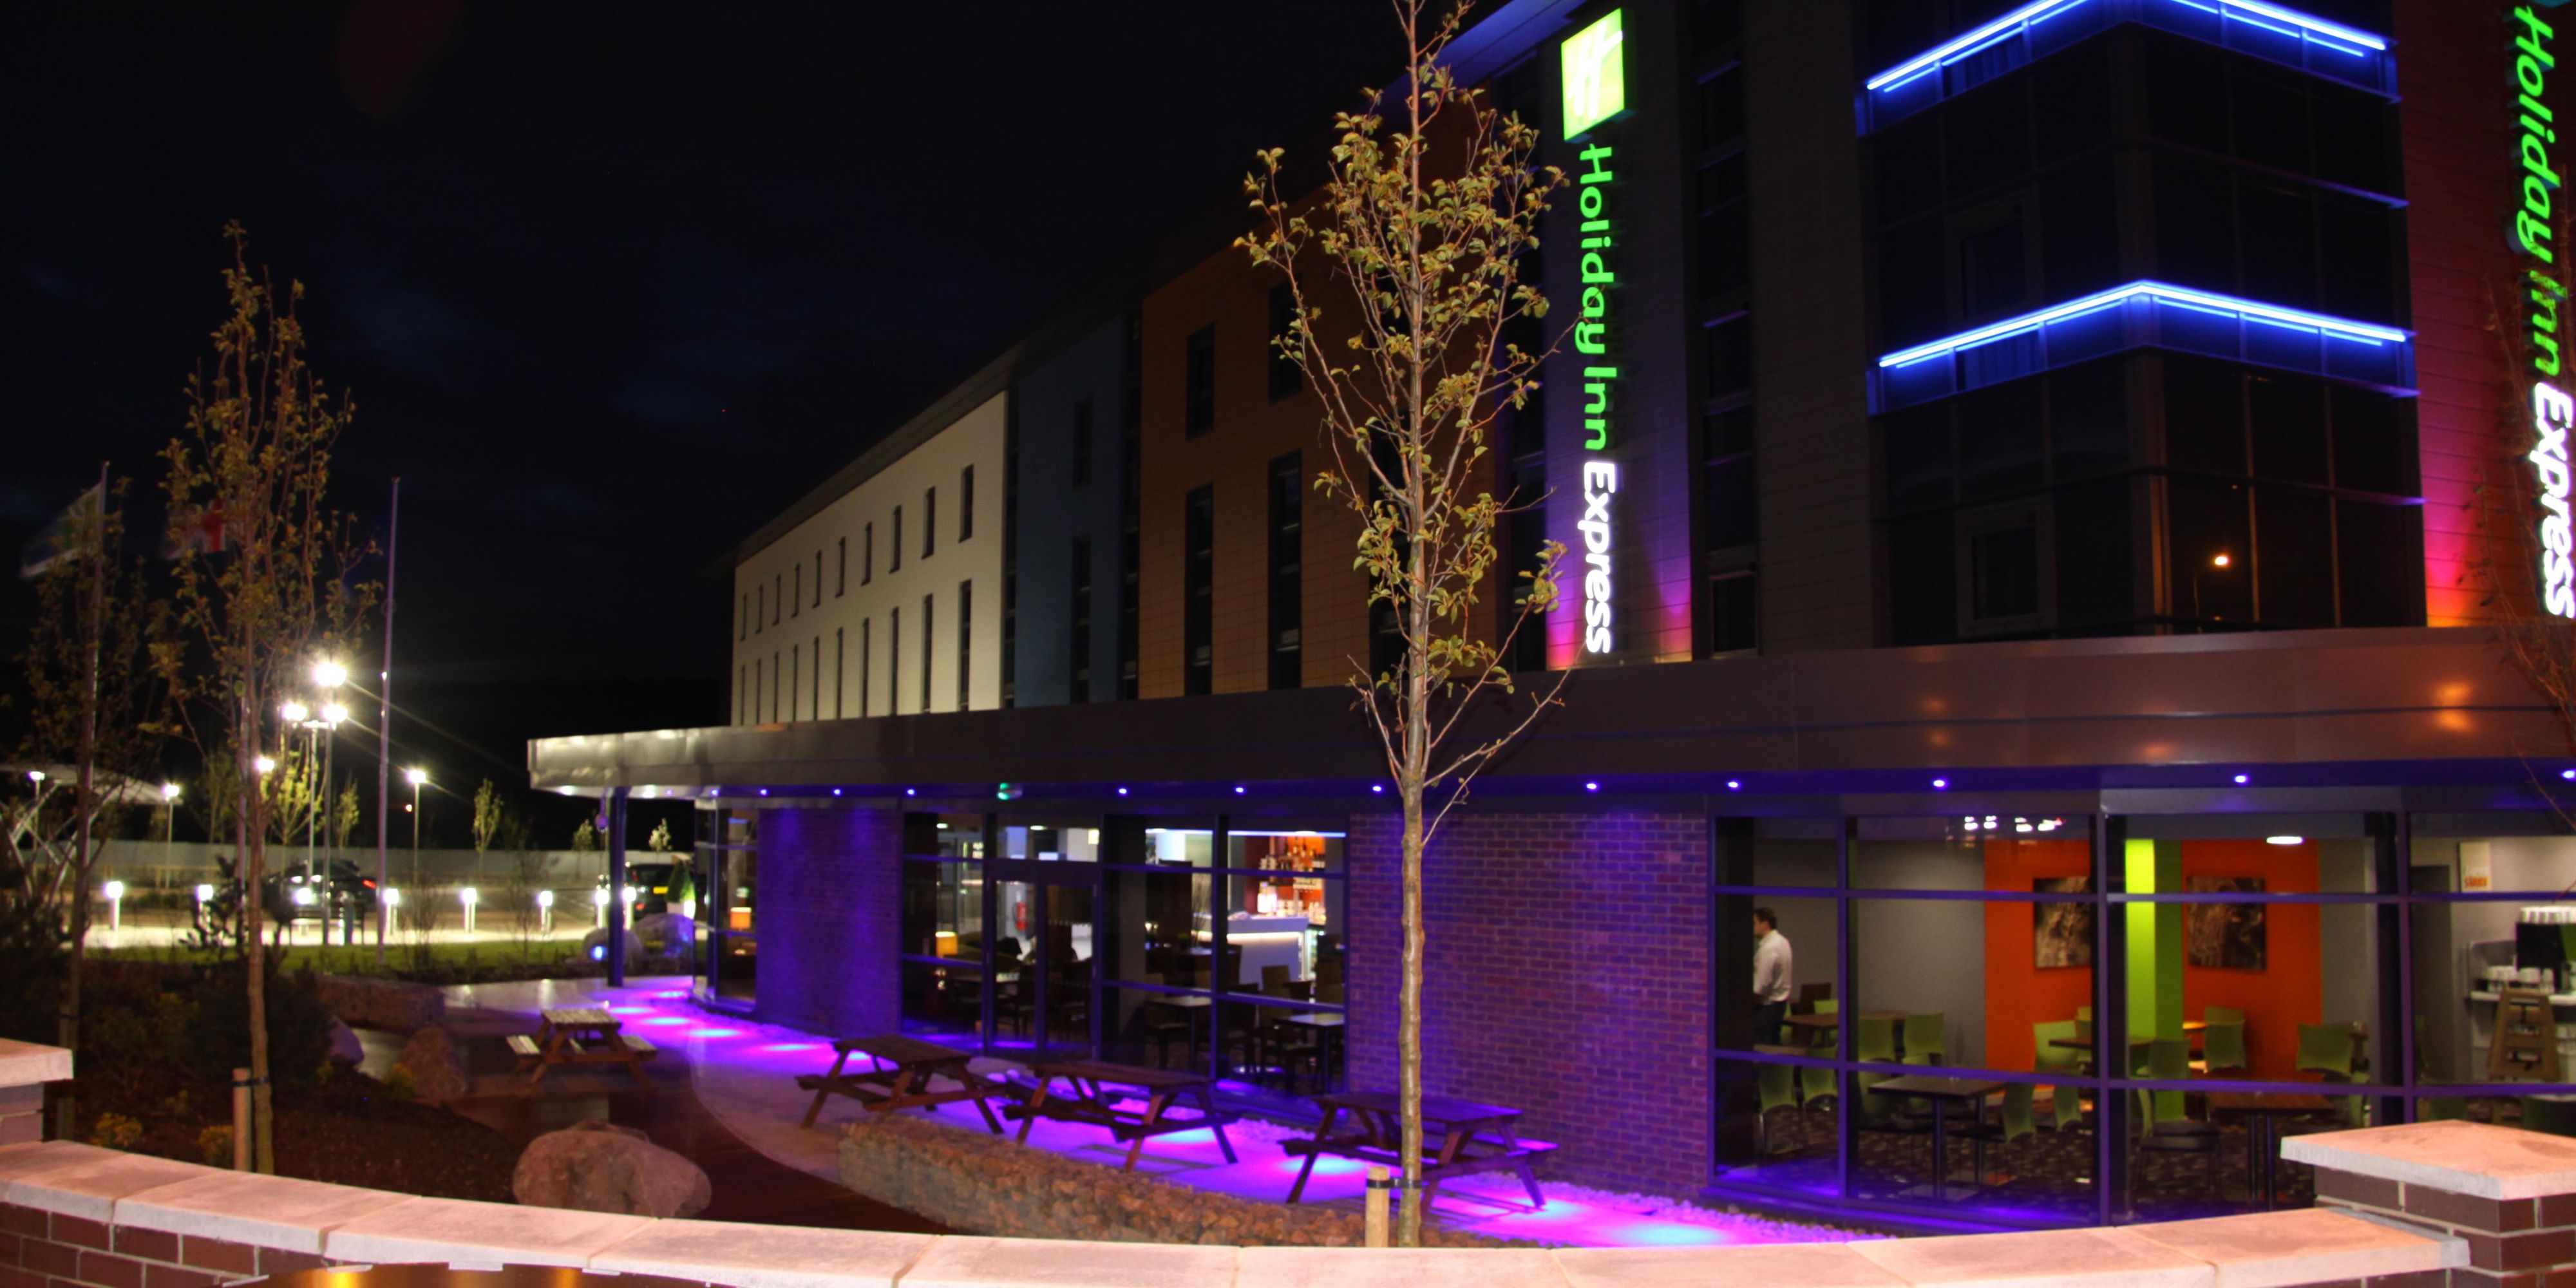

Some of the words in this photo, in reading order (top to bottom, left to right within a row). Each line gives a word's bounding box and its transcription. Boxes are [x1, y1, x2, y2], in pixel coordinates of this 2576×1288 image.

[2514, 5, 2561, 264] Holiday
[1575, 143, 1615, 355] Holiday
[2529, 269, 2568, 377] Inn
[1583, 366, 1617, 450] Inn
[2530, 381, 2576, 618] Express
[1576, 459, 1616, 654] Express
